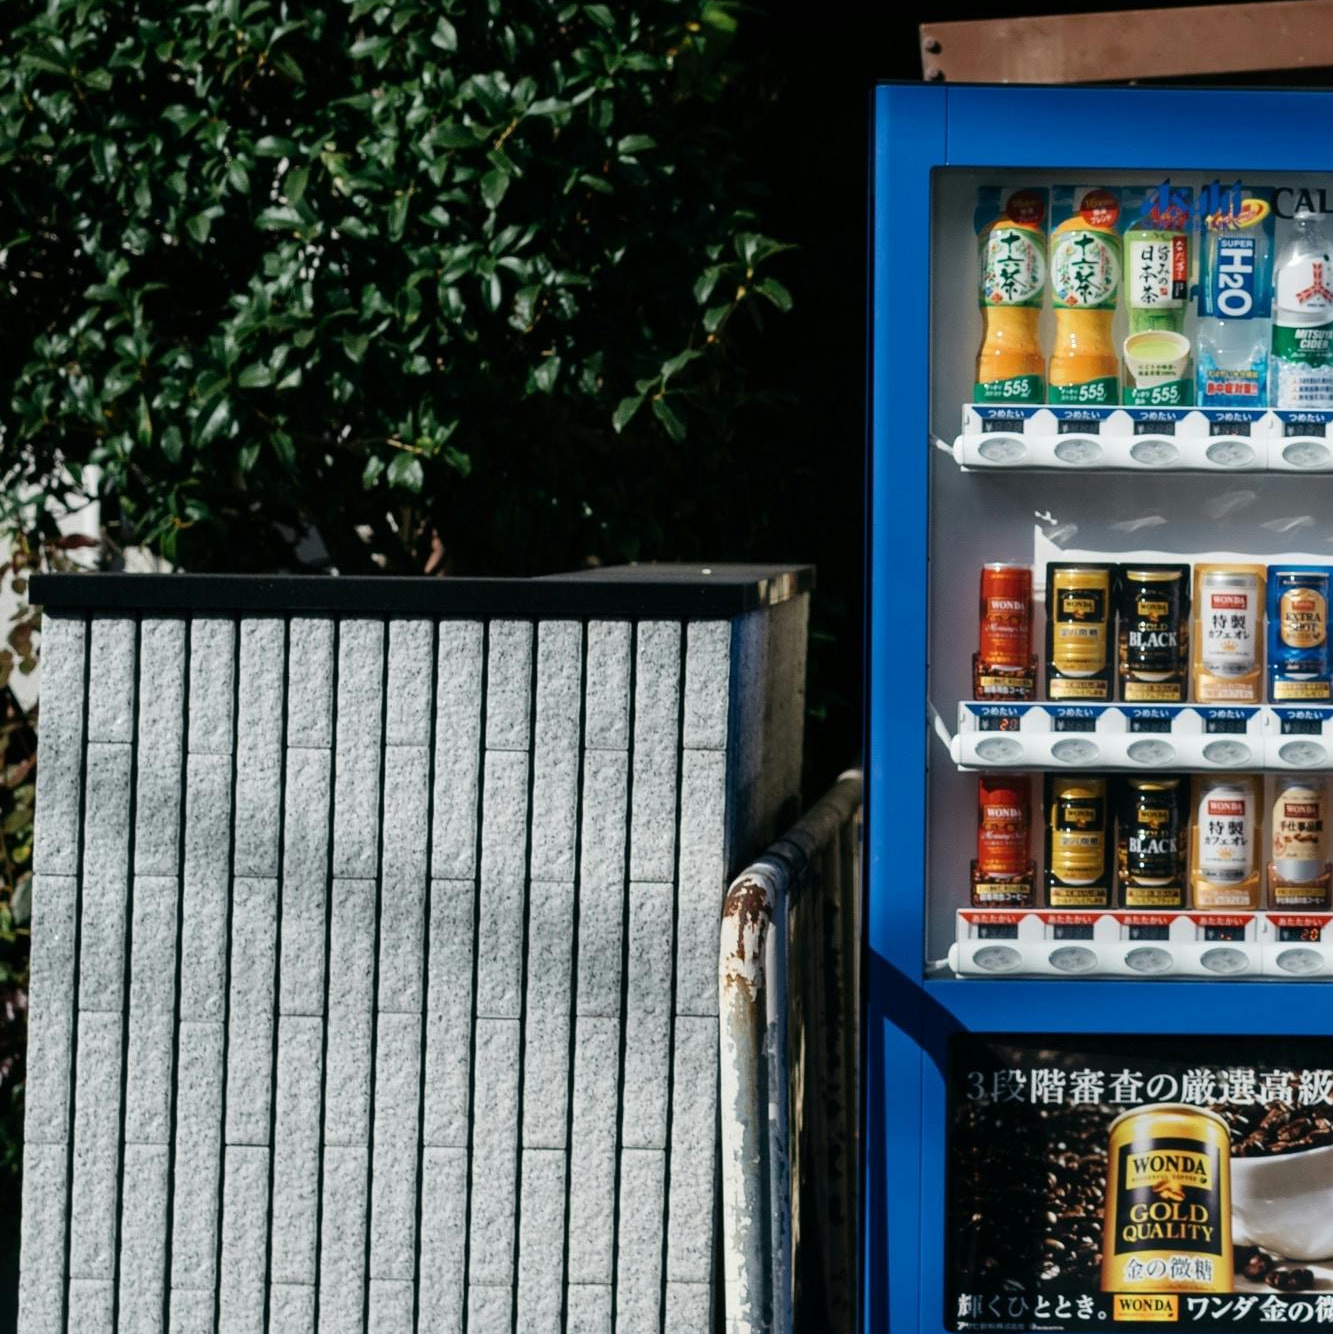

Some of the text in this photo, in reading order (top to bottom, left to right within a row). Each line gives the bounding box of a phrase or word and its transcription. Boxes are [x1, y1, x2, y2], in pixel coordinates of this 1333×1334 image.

[1221, 240, 1253, 248] SUPER
[997, 231, 1028, 301] 十六茶
[1071, 234, 1103, 304] 十六茶
[1139, 245, 1159, 304] 日本茶
[1217, 248, 1253, 317] H2O
[1295, 329, 1333, 339] MITSUYA
[1299, 339, 1329, 349] CIDER
[988, 410, 1025, 418] つめたい
[1064, 411, 1101, 419] つめたい
[1140, 412, 1177, 420] つめたい
[1216, 413, 1252, 421] つめたい
[1289, 413, 1325, 422] つめたい
[1213, 595, 1246, 604] WONDA
[1213, 615, 1246, 629] 特製
[1286, 613, 1321, 622] EXTRA
[1289, 624, 1317, 633] SHOT
[1129, 631, 1177, 647] BLACK
[1208, 630, 1250, 640] カフェオレ
[981, 706, 1018, 716] つめたい
[1057, 707, 1093, 717] つめたい
[1133, 708, 1170, 718] つめたい
[1209, 709, 1245, 719] つめたい
[1287, 710, 1323, 720] つめたい
[1209, 800, 1243, 810] WONDA
[1208, 821, 1243, 835] 特製
[1129, 836, 1177, 854] BLACK
[1204, 836, 1248, 846] カフェオレ
[971, 913, 1016, 923] あたたかい
[1047, 914, 1092, 924] あたたかい
[1124, 915, 1168, 924] あたたかい
[1199, 916, 1244, 925] あたたかい
[1278, 917, 1322, 927] あたたかい
[1132, 1154, 1206, 1176] WONDA
[1129, 1201, 1209, 1223] GOLD
[1122, 1221, 1214, 1243] QUALITY
[1126, 1257, 1214, 1283] 金の微糖
[957, 1293, 1108, 1320] 輝くひととき。
[1119, 1299, 1173, 1312] WONDA
